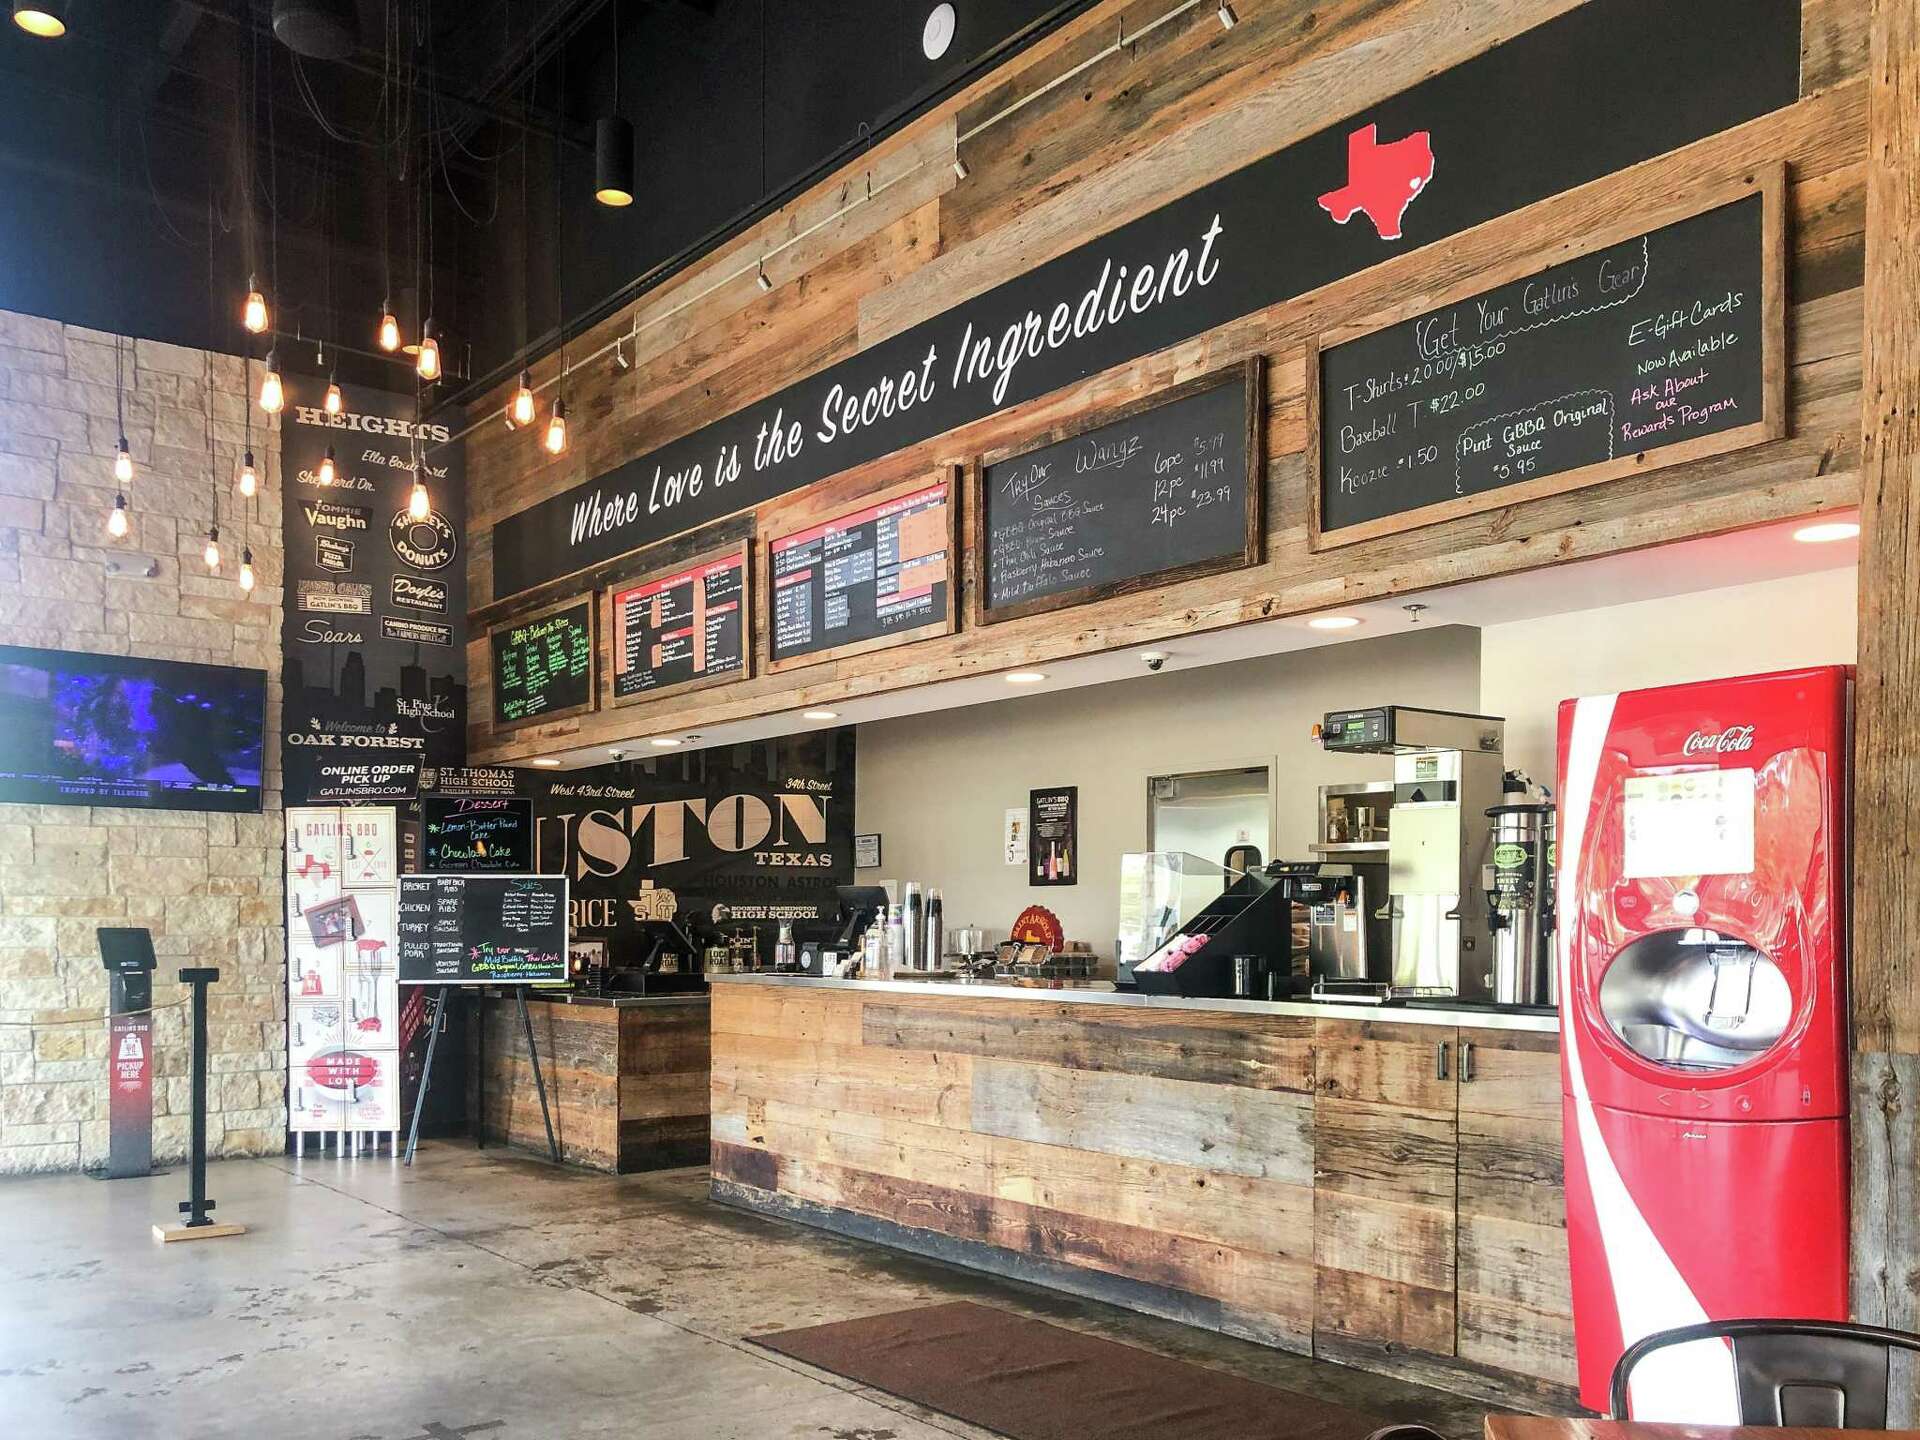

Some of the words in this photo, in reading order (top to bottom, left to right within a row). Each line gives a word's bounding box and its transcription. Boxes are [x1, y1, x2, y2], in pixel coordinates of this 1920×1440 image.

[1423, 312, 1459, 356] Get
[1477, 299, 1510, 334] Your
[1599, 259, 1641, 294] Gear
[1689, 291, 1743, 327] Cards
[1668, 331, 1739, 368] Available
[570, 488, 639, 546] Where
[649, 464, 703, 514] Love
[714, 445, 741, 487] is
[754, 407, 803, 471] the
[816, 344, 938, 443] Secret
[953, 213, 1225, 405] Ingredient
[1631, 384, 1660, 405] Ask
[1664, 368, 1710, 397] About
[295, 406, 452, 443] HEIGHTS
[1340, 411, 1397, 454] Baseball
[1463, 434, 1493, 456] Pint
[1503, 415, 1546, 444] GBBQ
[1553, 397, 1609, 428] Original
[1621, 412, 1675, 442] Rewards
[1506, 438, 1543, 458] Sauce
[304, 507, 367, 530] Vaughn
[396, 540, 449, 566] DONUTS
[295, 619, 364, 643] Sears
[396, 705, 421, 718] High
[422, 708, 456, 719] School
[287, 733, 336, 746] OAK
[340, 735, 425, 749] FOREST
[1683, 725, 1755, 756] Coca-Cola
[321, 765, 369, 776] ONLINE
[371, 764, 415, 775] ORDER
[340, 775, 371, 784] PICK
[374, 774, 391, 784] UP
[461, 768, 515, 779] THOMAS
[440, 777, 468, 786] HIGH
[471, 779, 515, 788] SCHOOL
[550, 784, 575, 796] West
[577, 784, 603, 797] 43rd
[604, 785, 635, 799] Street
[785, 778, 804, 791] 34th
[805, 779, 833, 791] Street
[536, 793, 832, 882] USTON
[753, 851, 833, 867] TEXAS
[399, 902, 431, 913] CHICKEN
[731, 911, 767, 919] HIGH
[768, 911, 819, 919] SCHOOL
[400, 922, 430, 933] TURKEY
[403, 941, 430, 950] PULLED
[326, 1057, 361, 1066] MADE
[328, 1067, 360, 1075] WITH
